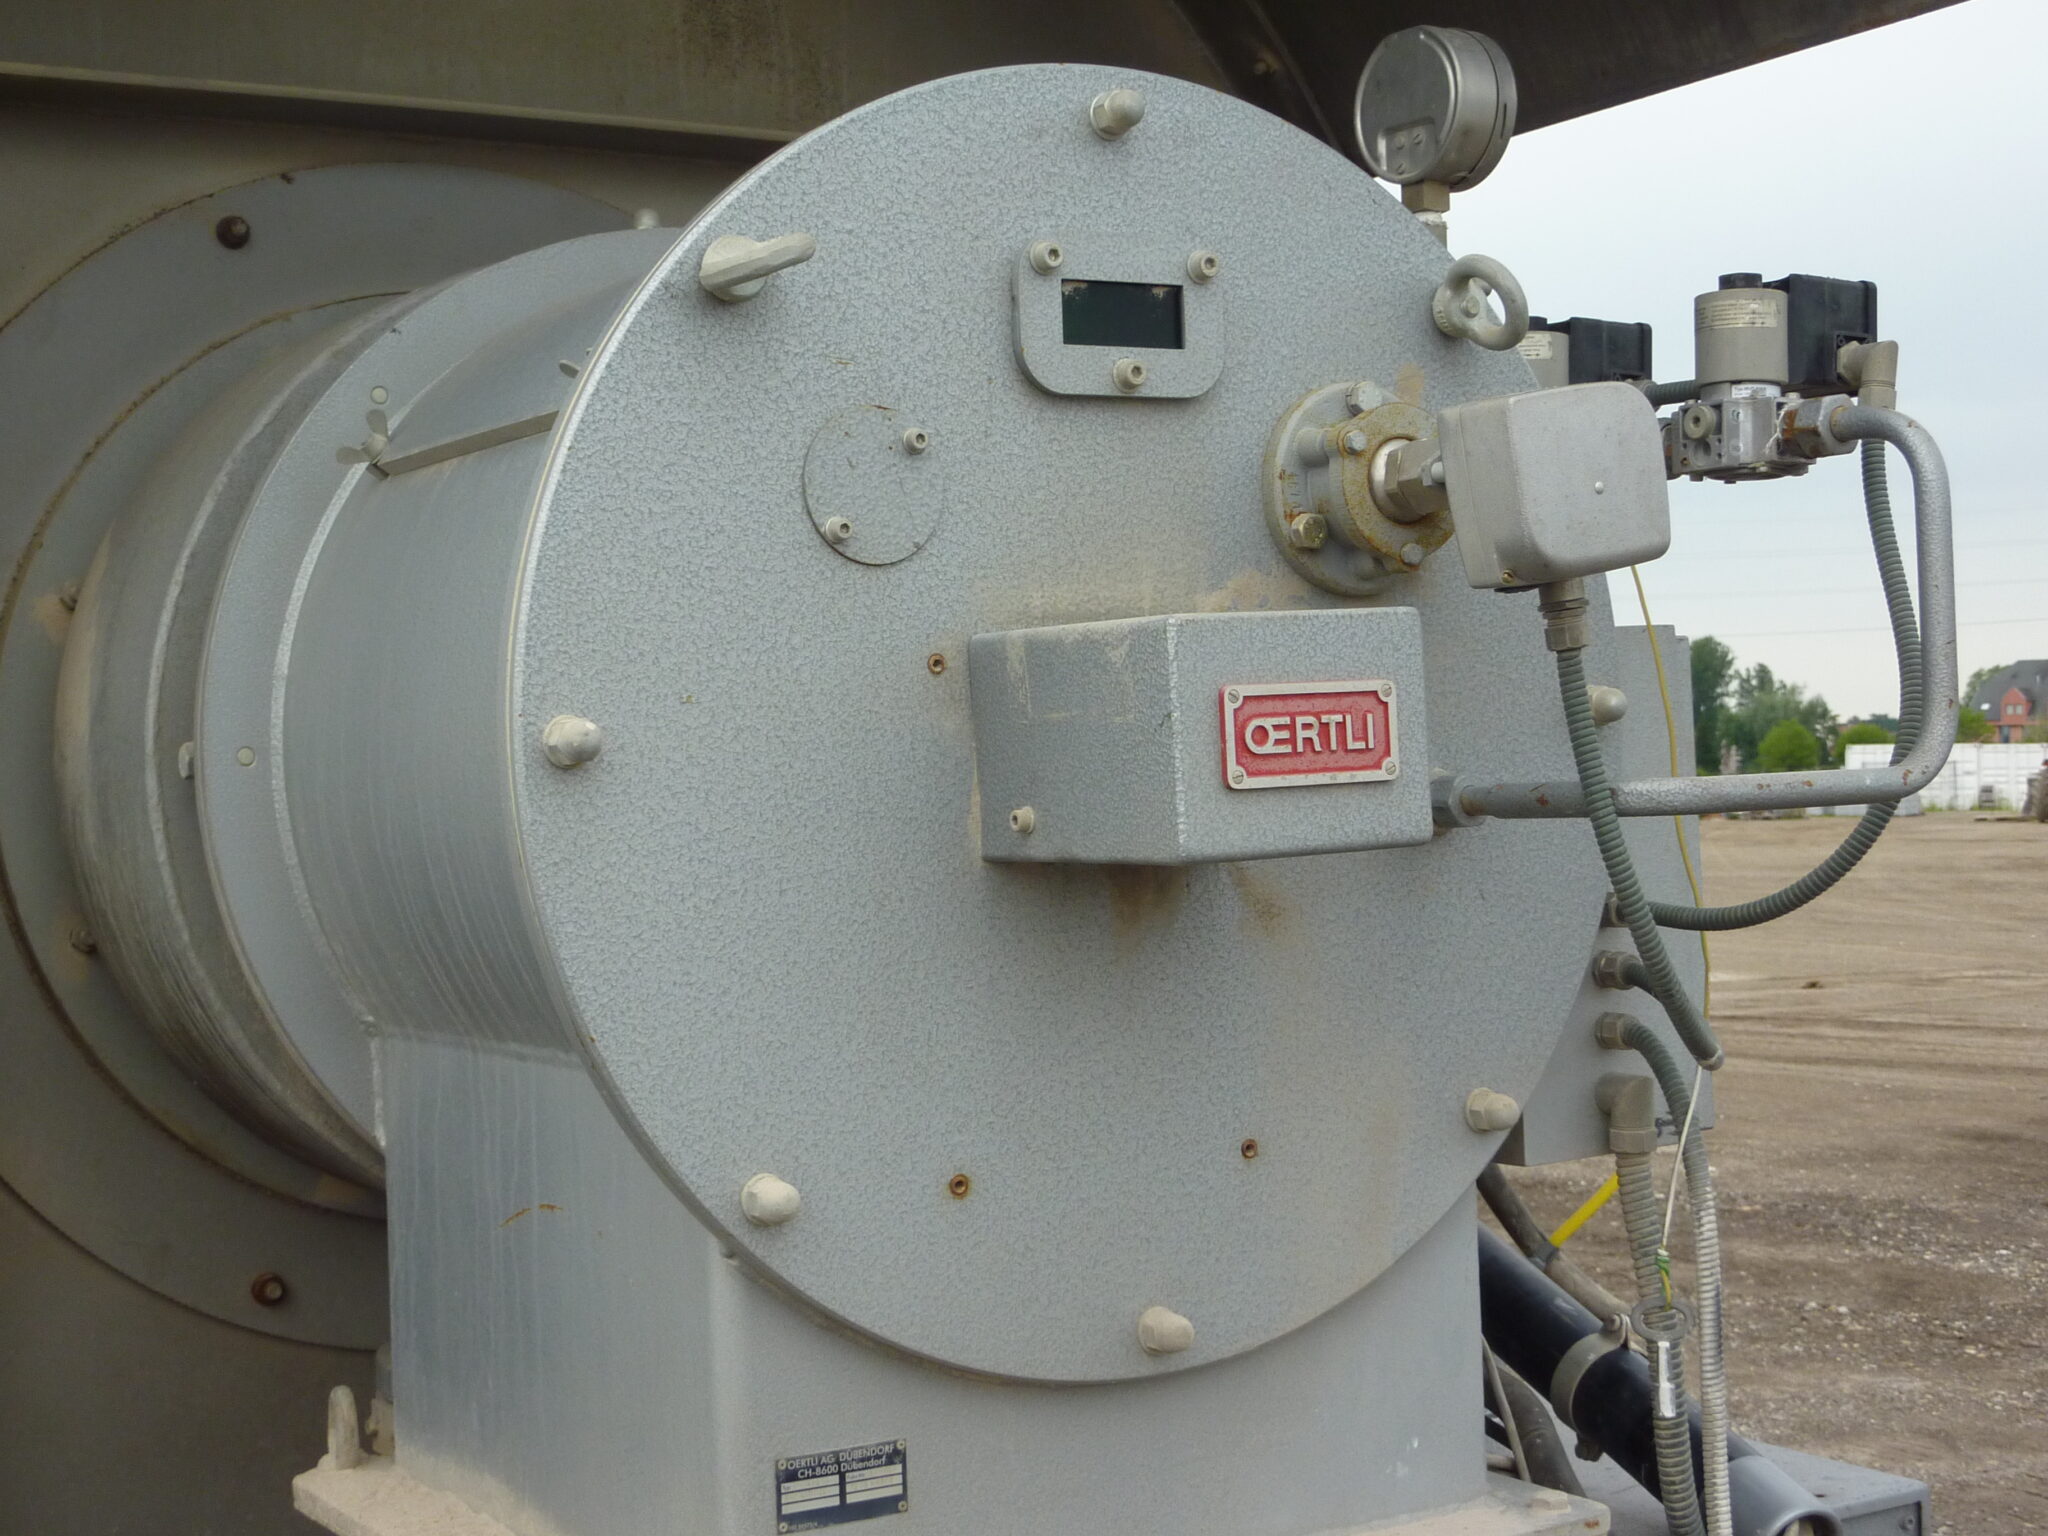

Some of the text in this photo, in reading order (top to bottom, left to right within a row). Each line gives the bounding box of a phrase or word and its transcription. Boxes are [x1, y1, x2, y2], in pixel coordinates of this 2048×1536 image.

[787, 1458, 818, 1470] OERTLI
[820, 1455, 834, 1465] AG
[798, 1465, 838, 1478] CH-8600
